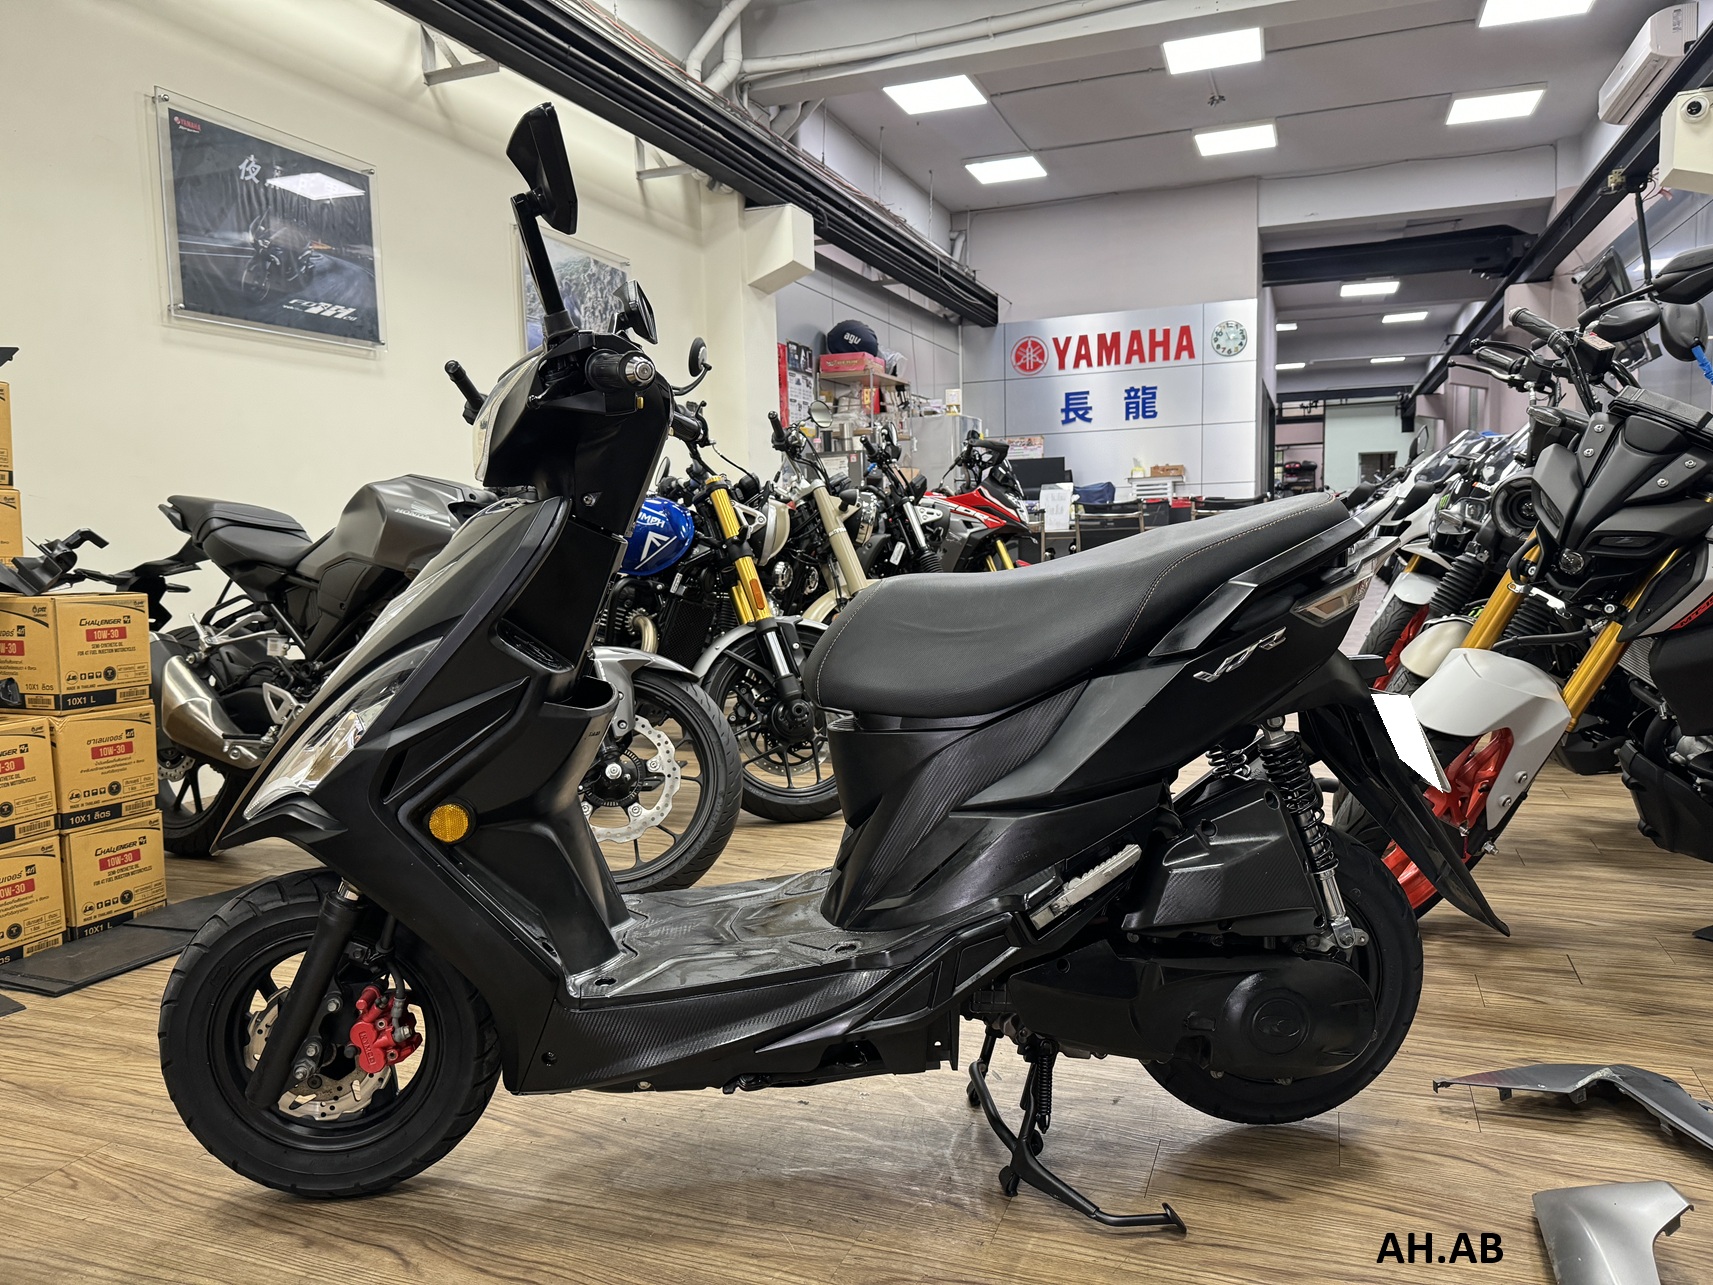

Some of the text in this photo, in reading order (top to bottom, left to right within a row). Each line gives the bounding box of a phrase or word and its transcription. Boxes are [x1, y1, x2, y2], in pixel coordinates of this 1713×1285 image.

[1052, 325, 1196, 371] YAMAHA
[1060, 385, 1158, 426] 長龍
[394, 508, 430, 520] HONDA
[79, 618, 121, 626] CHALLENGER
[94, 629, 119, 639] 10W-30
[0, 643, 17, 654] W-30
[67, 697, 86, 706] 10X1
[99, 745, 125, 757] 10W-30
[70, 814, 91, 824] 10X1
[95, 840, 137, 856] CHALLENGER
[107, 853, 133, 867] 10W-30
[0, 883, 26, 899] 0W-30
[84, 925, 104, 936] 10X1
